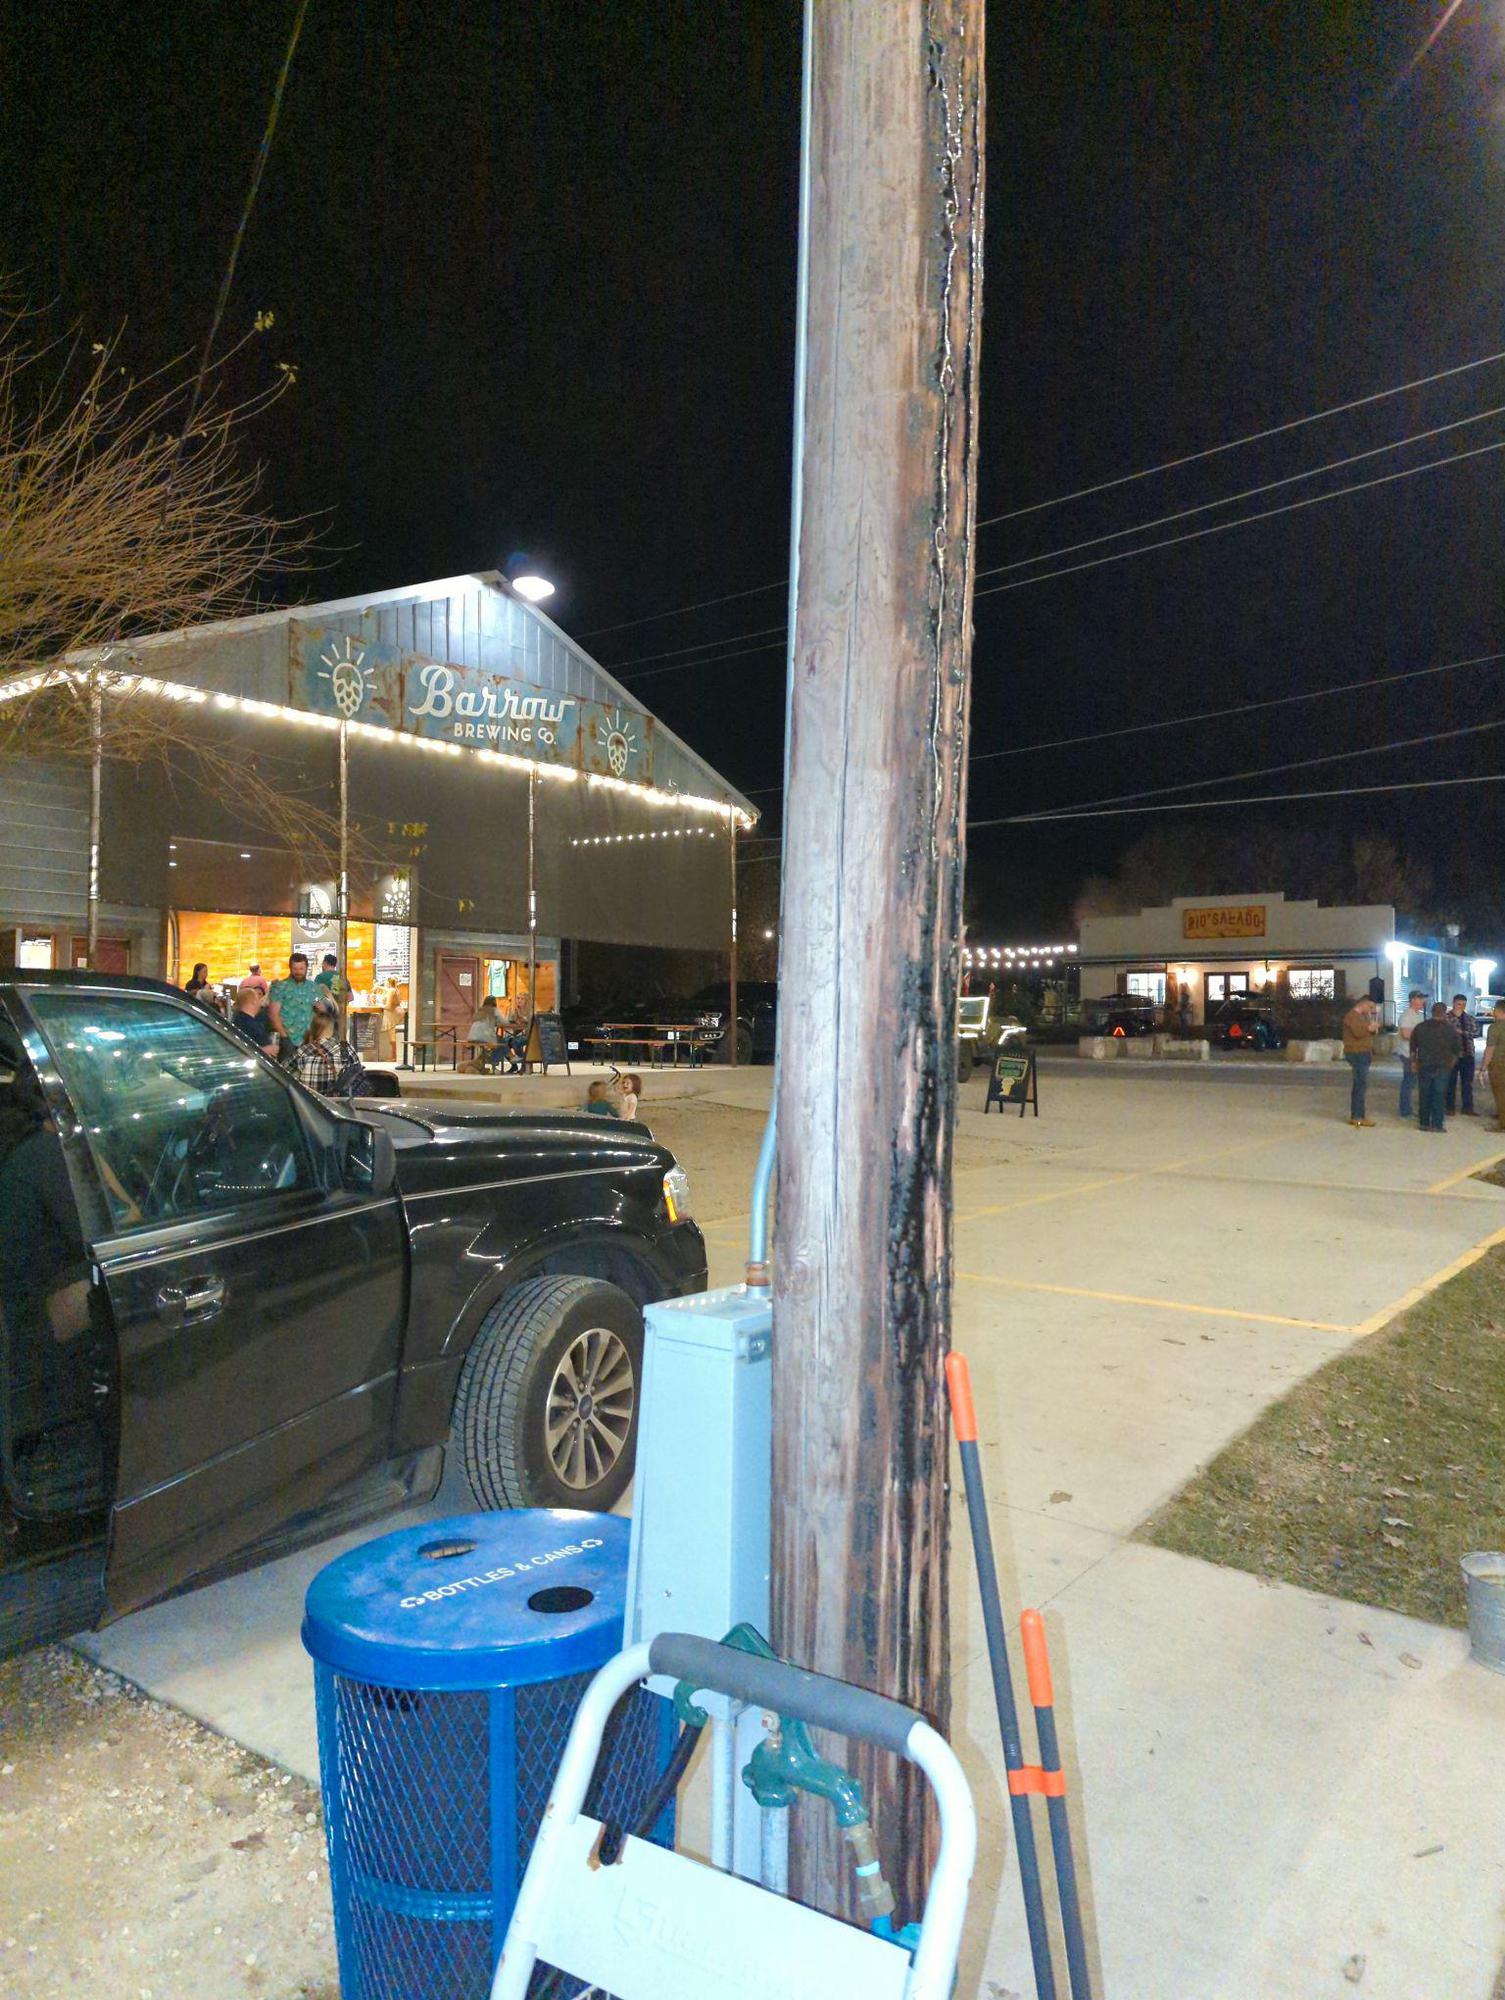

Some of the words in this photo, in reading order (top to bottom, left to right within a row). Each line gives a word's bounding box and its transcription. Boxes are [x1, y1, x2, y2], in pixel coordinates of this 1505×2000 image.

[408, 664, 576, 722] Barrow
[454, 722, 532, 742] BREWING
[422, 1567, 515, 1601] BOTTLES
[515, 1562, 531, 1572] &
[531, 1545, 584, 1566] CANS
